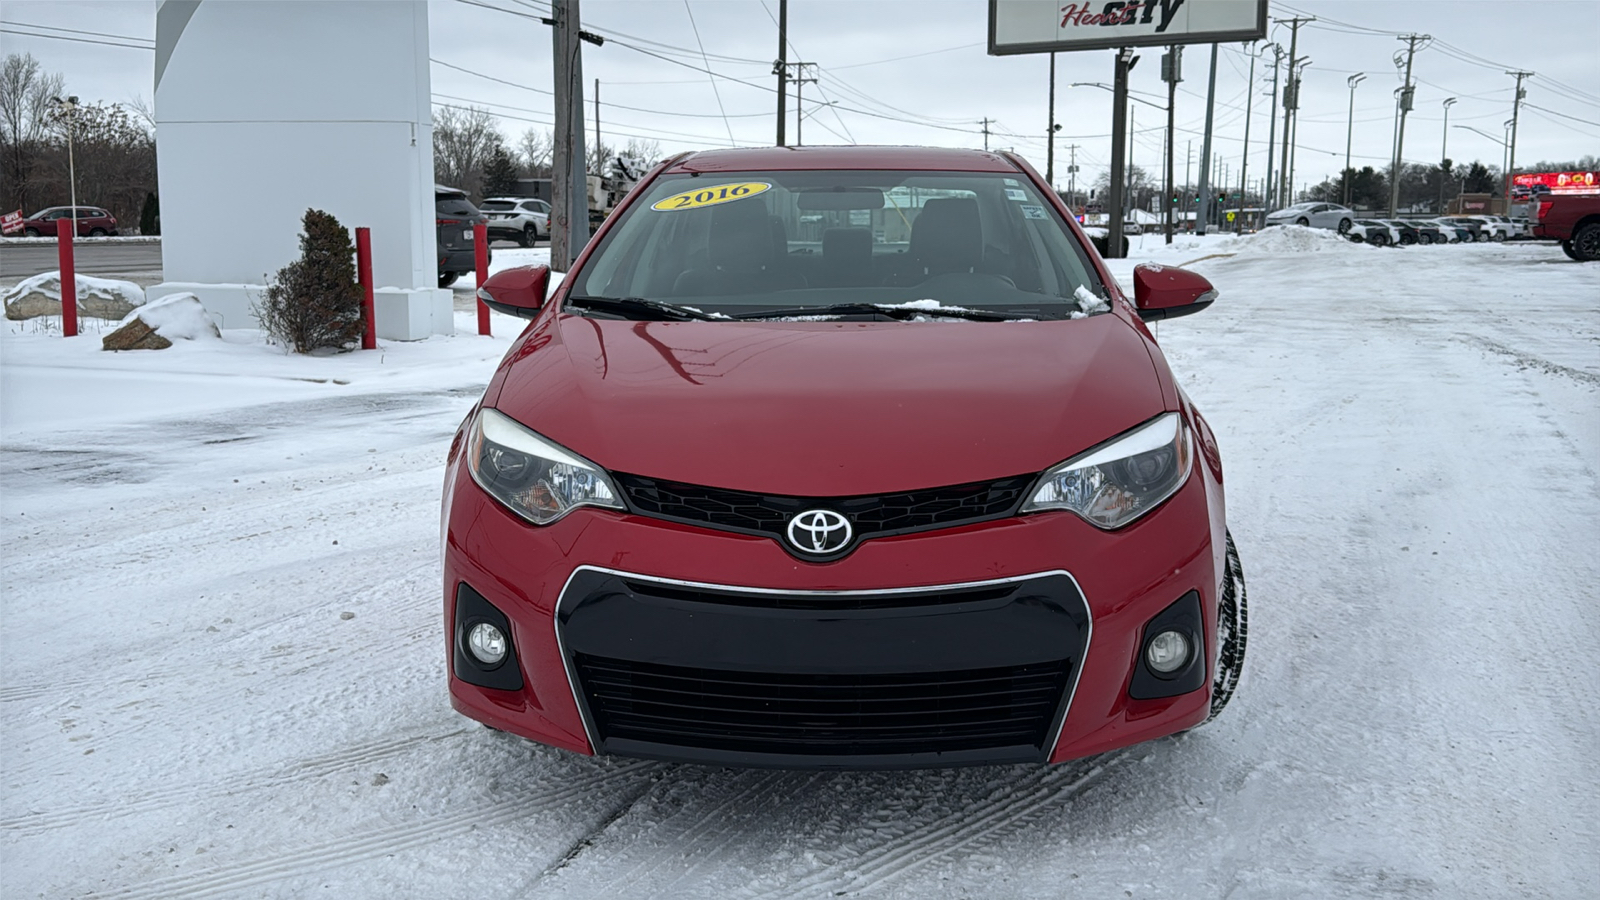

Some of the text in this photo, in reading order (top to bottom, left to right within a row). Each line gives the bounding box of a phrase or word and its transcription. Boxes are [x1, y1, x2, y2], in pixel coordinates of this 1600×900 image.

[1060, 1, 1147, 28] Heart
[673, 183, 750, 209] 2016
[4, 212, 19, 223] OPEN
